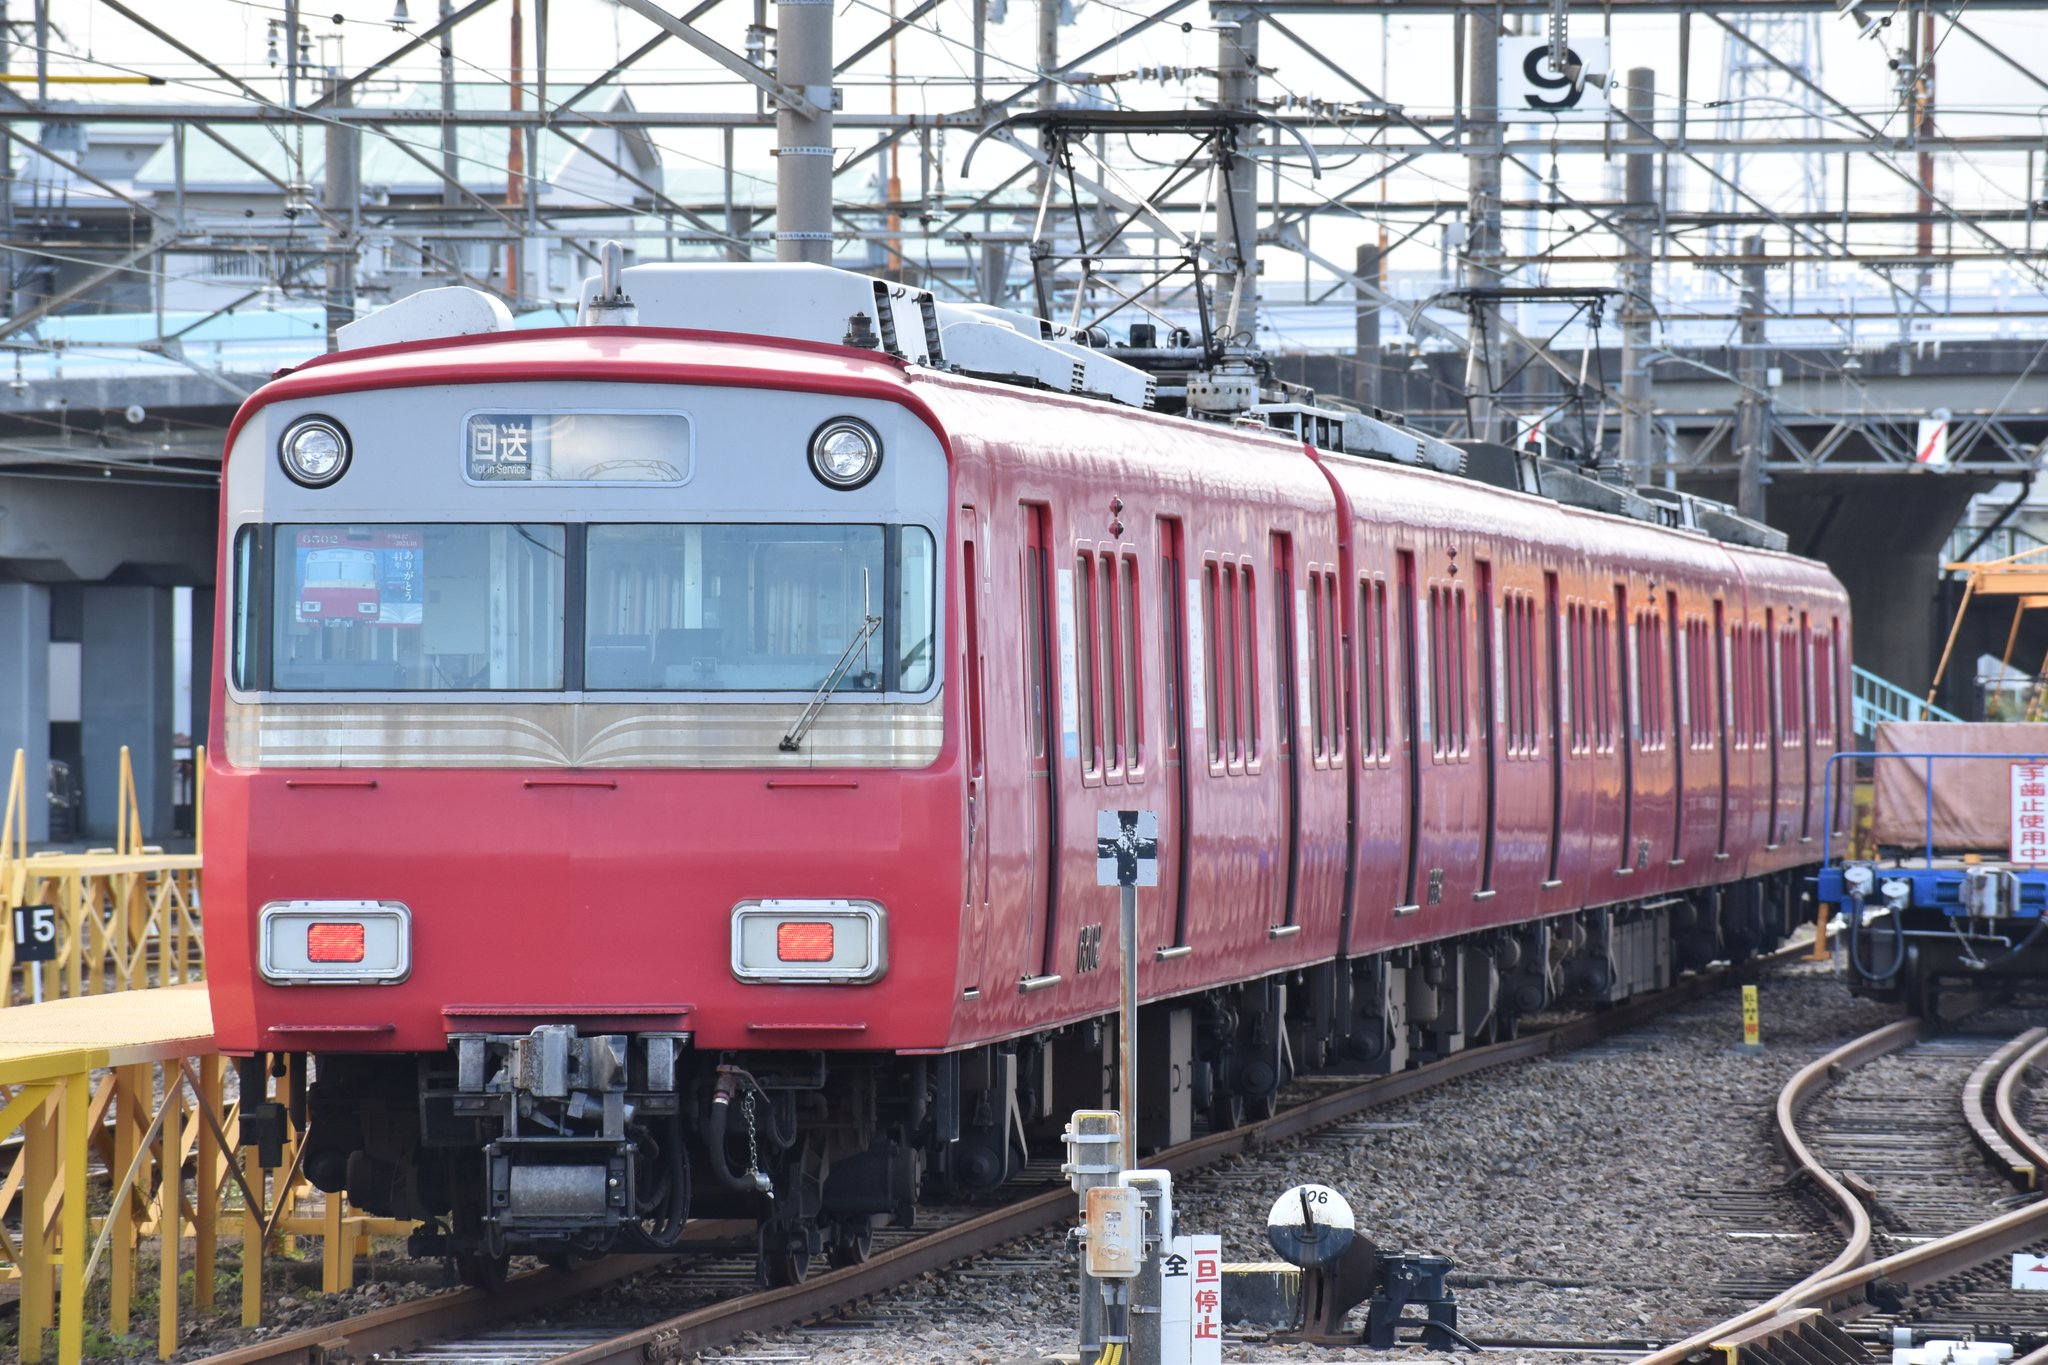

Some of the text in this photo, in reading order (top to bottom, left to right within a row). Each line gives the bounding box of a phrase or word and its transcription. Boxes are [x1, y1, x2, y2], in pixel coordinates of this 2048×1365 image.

[1523, 45, 1585, 110] 9
[471, 423, 527, 462] 回送
[471, 462, 526, 474] Not in Service
[403, 550, 414, 602] ありがとう
[2018, 766, 2047, 861] 手歯止使用中
[15, 909, 56, 944] 15
[1164, 1253, 1189, 1278] 全
[1193, 1249, 1220, 1339] 一旦停止
